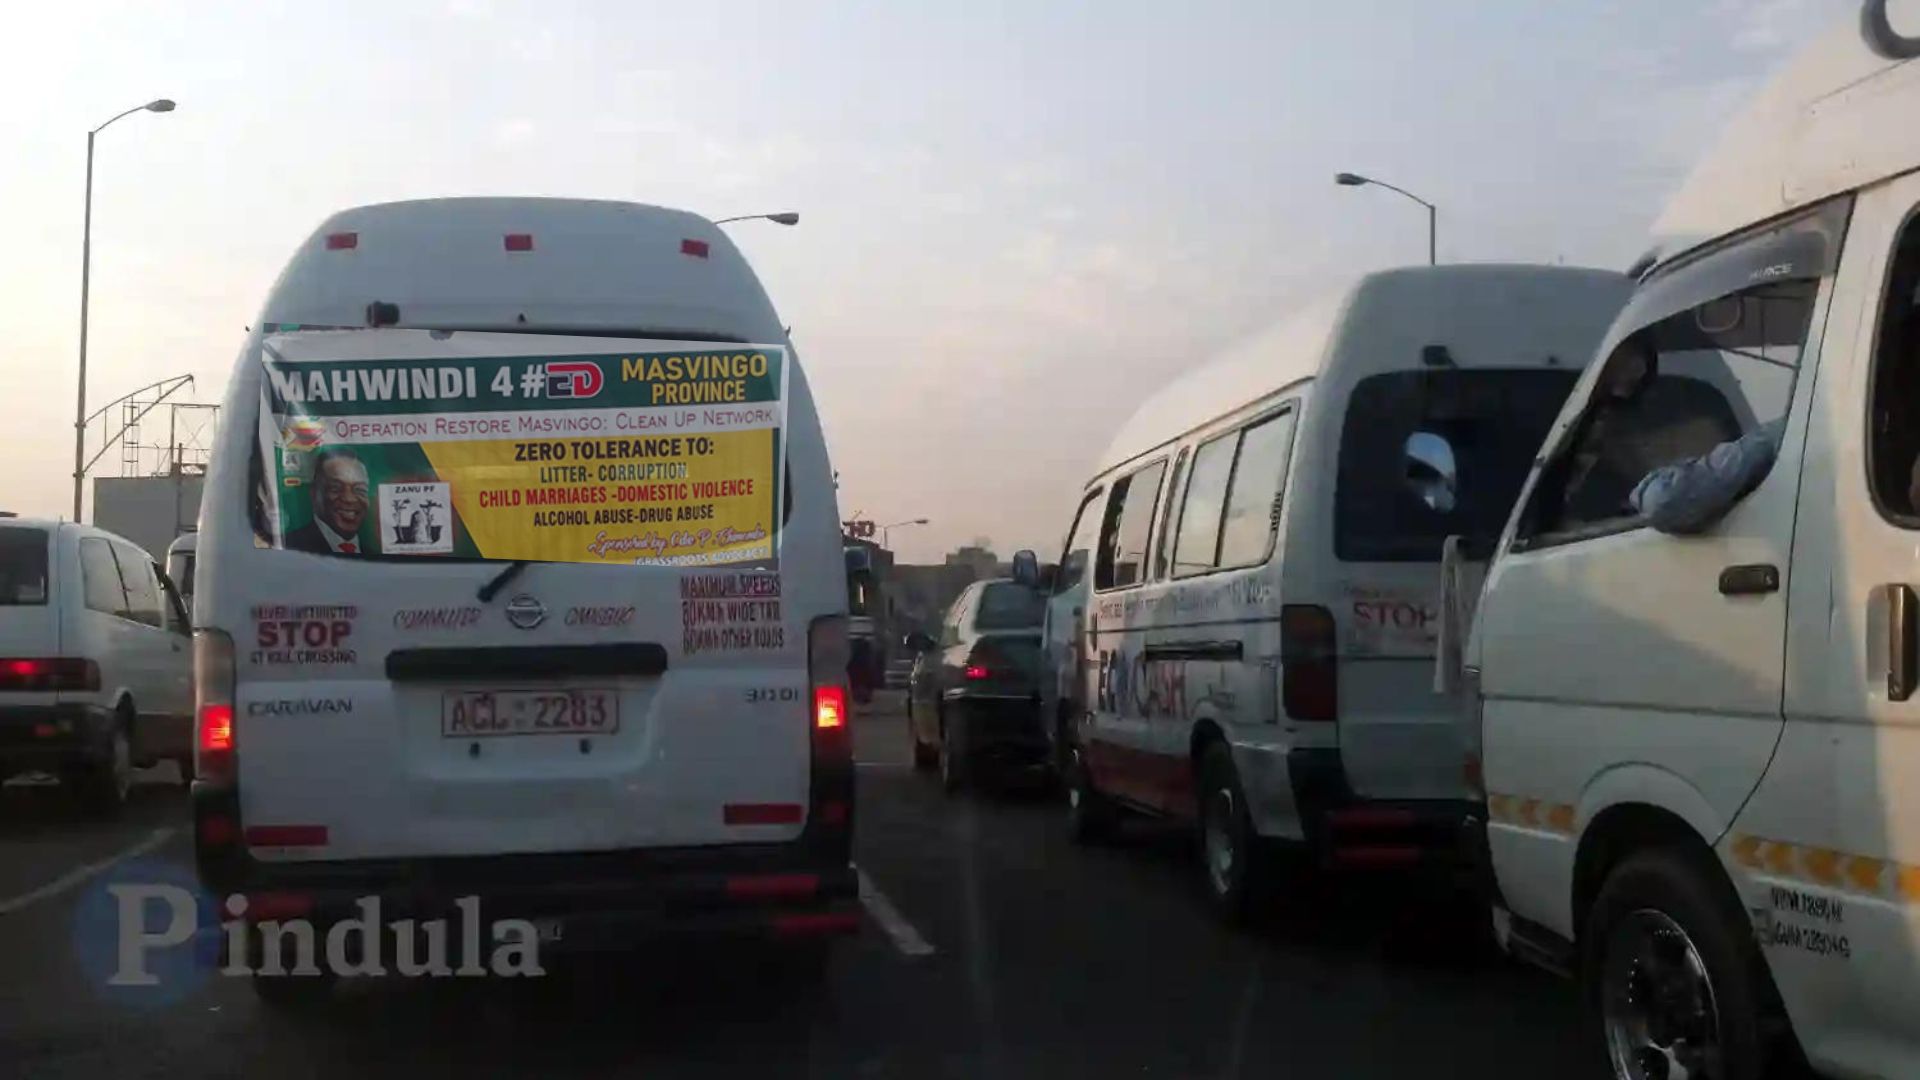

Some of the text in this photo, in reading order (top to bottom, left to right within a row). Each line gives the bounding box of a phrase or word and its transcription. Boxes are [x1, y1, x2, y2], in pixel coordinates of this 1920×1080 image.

[621, 354, 768, 382] MASVINGO
[272, 366, 476, 403] MAHWINDI
[491, 366, 514, 397] 4
[651, 380, 746, 404] PROVINCE
[336, 419, 428, 439] OPERATION
[435, 417, 511, 436] RESTORE
[616, 412, 670, 429] CLEAN
[674, 411, 696, 428] UP
[703, 409, 773, 427] NETWORK
[515, 437, 714, 462] ZERO TOLERANCE TO:
[598, 462, 688, 483] CORRUPTION
[395, 486, 421, 494] ZANU
[479, 488, 520, 508] CHILD
[526, 485, 607, 506] MARRIAGES
[692, 479, 754, 499] VIOLENCE
[534, 509, 589, 527] ALCOHOL
[677, 504, 714, 521] ABUSE
[257, 621, 352, 648] STOP
[247, 697, 353, 717] CARAVAN
[534, 694, 608, 728] 2283
